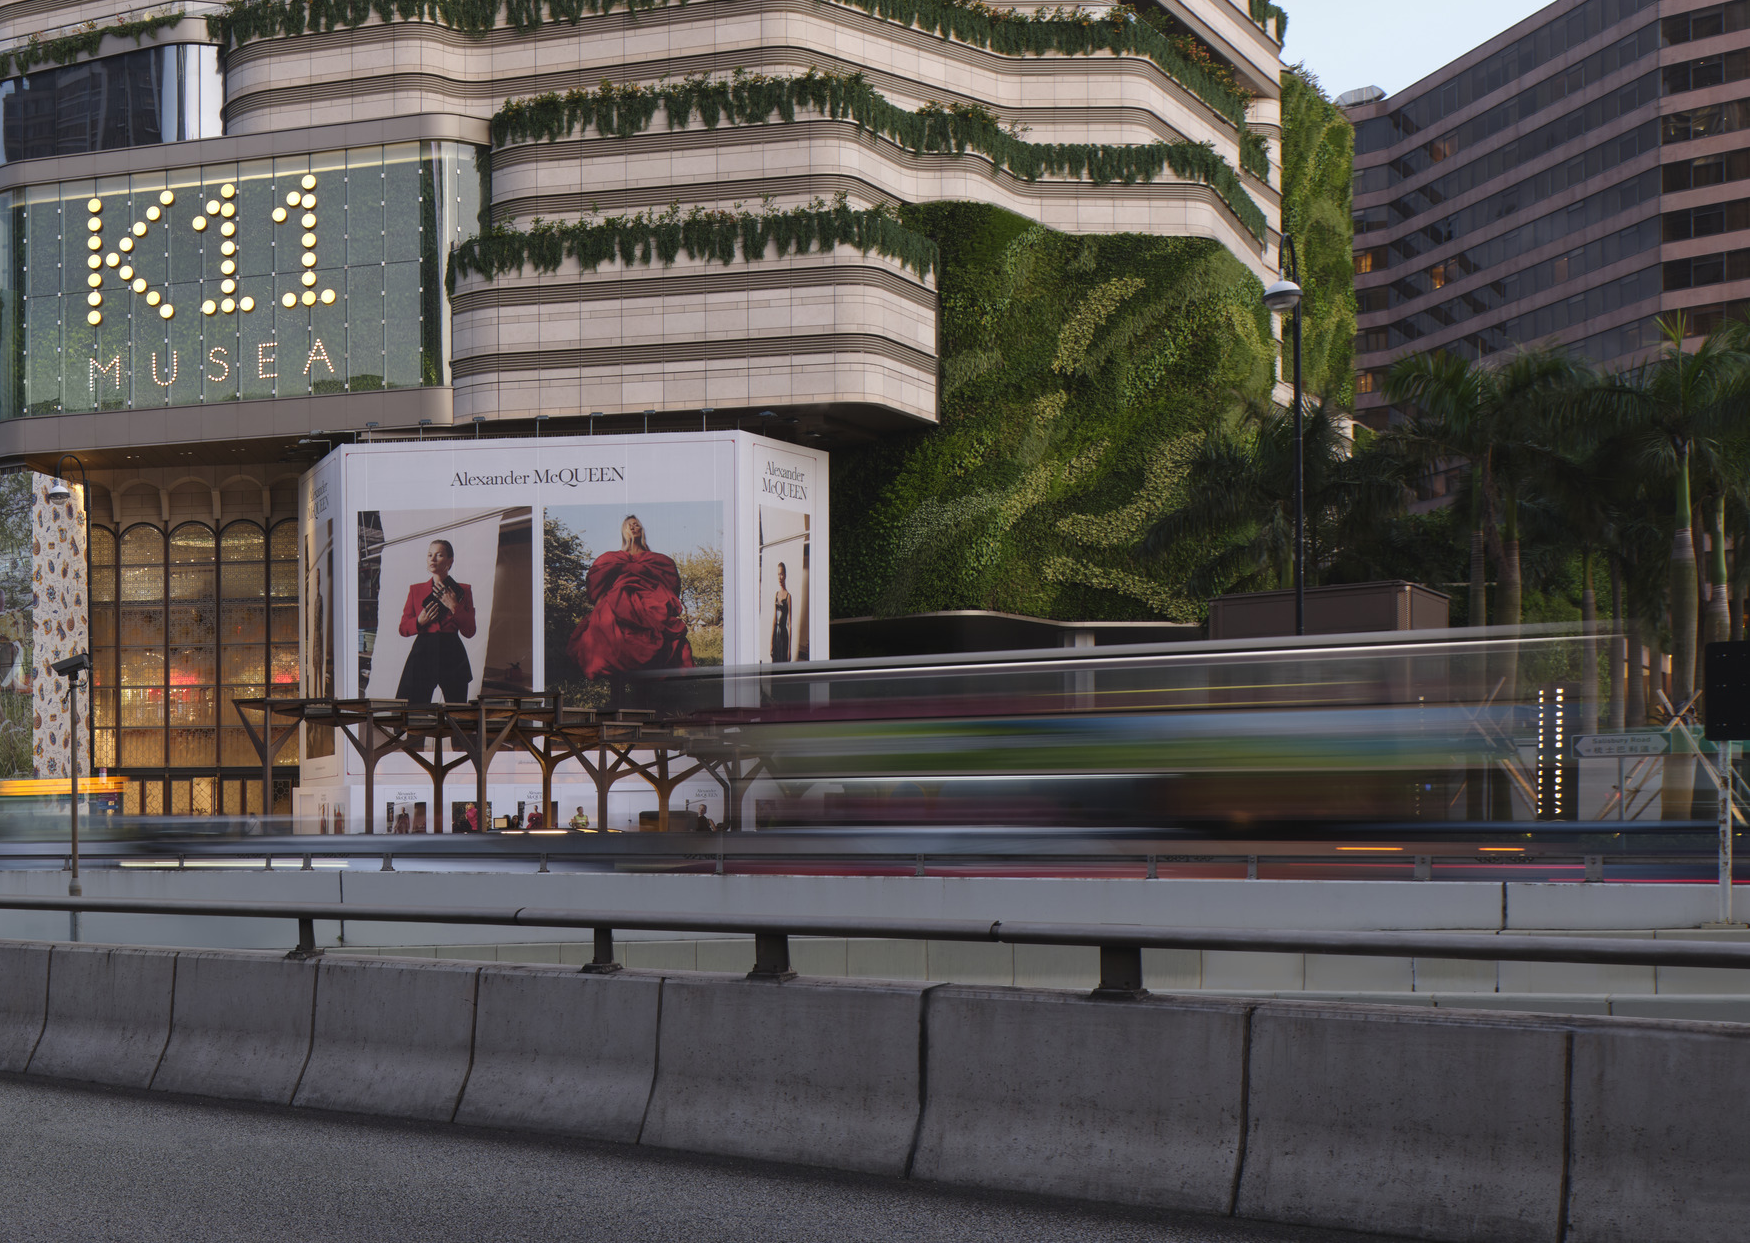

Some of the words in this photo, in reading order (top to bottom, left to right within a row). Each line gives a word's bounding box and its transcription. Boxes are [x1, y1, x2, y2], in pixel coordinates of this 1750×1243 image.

[87, 174, 336, 325] K11
[89, 339, 335, 392] MUSEA
[450, 471, 530, 487] Alexander
[533, 467, 625, 487] McQUEEN
[762, 477, 807, 500] McQUEEN
[765, 461, 805, 482] Alexander
[1555, 688, 1564, 748] DOCKSIDE
[1592, 737, 1629, 745] Salisbury
[1554, 754, 1563, 814] VICTORIA
